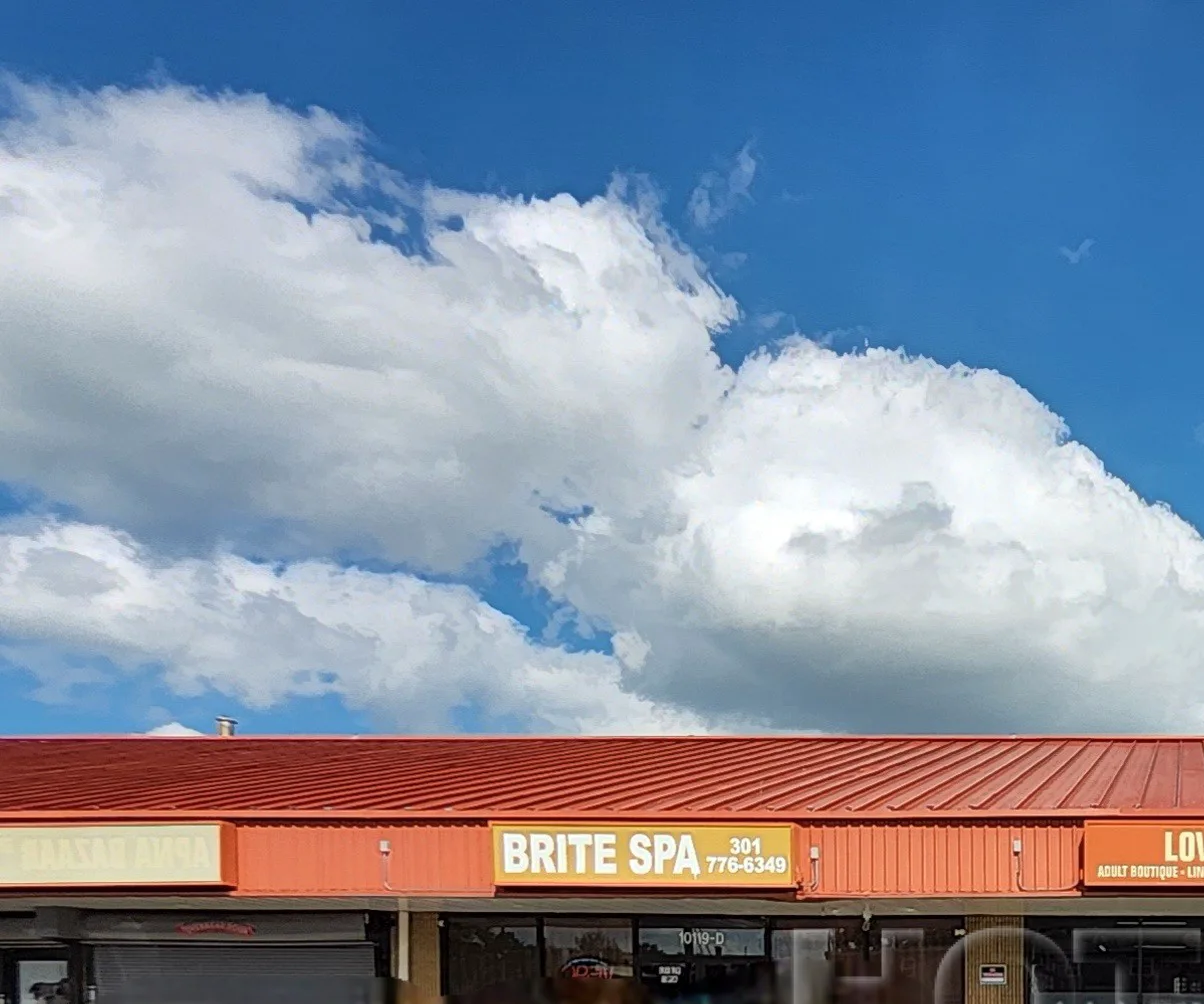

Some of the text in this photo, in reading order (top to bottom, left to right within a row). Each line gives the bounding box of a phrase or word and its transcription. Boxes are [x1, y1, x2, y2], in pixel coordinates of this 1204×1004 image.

[503, 833, 700, 875] BRITE SPA
[729, 837, 761, 855] 301
[706, 856, 787, 874] 776-6349
[1097, 865, 1128, 878] ADULT
[1131, 865, 1178, 880] BOUTIQUE
